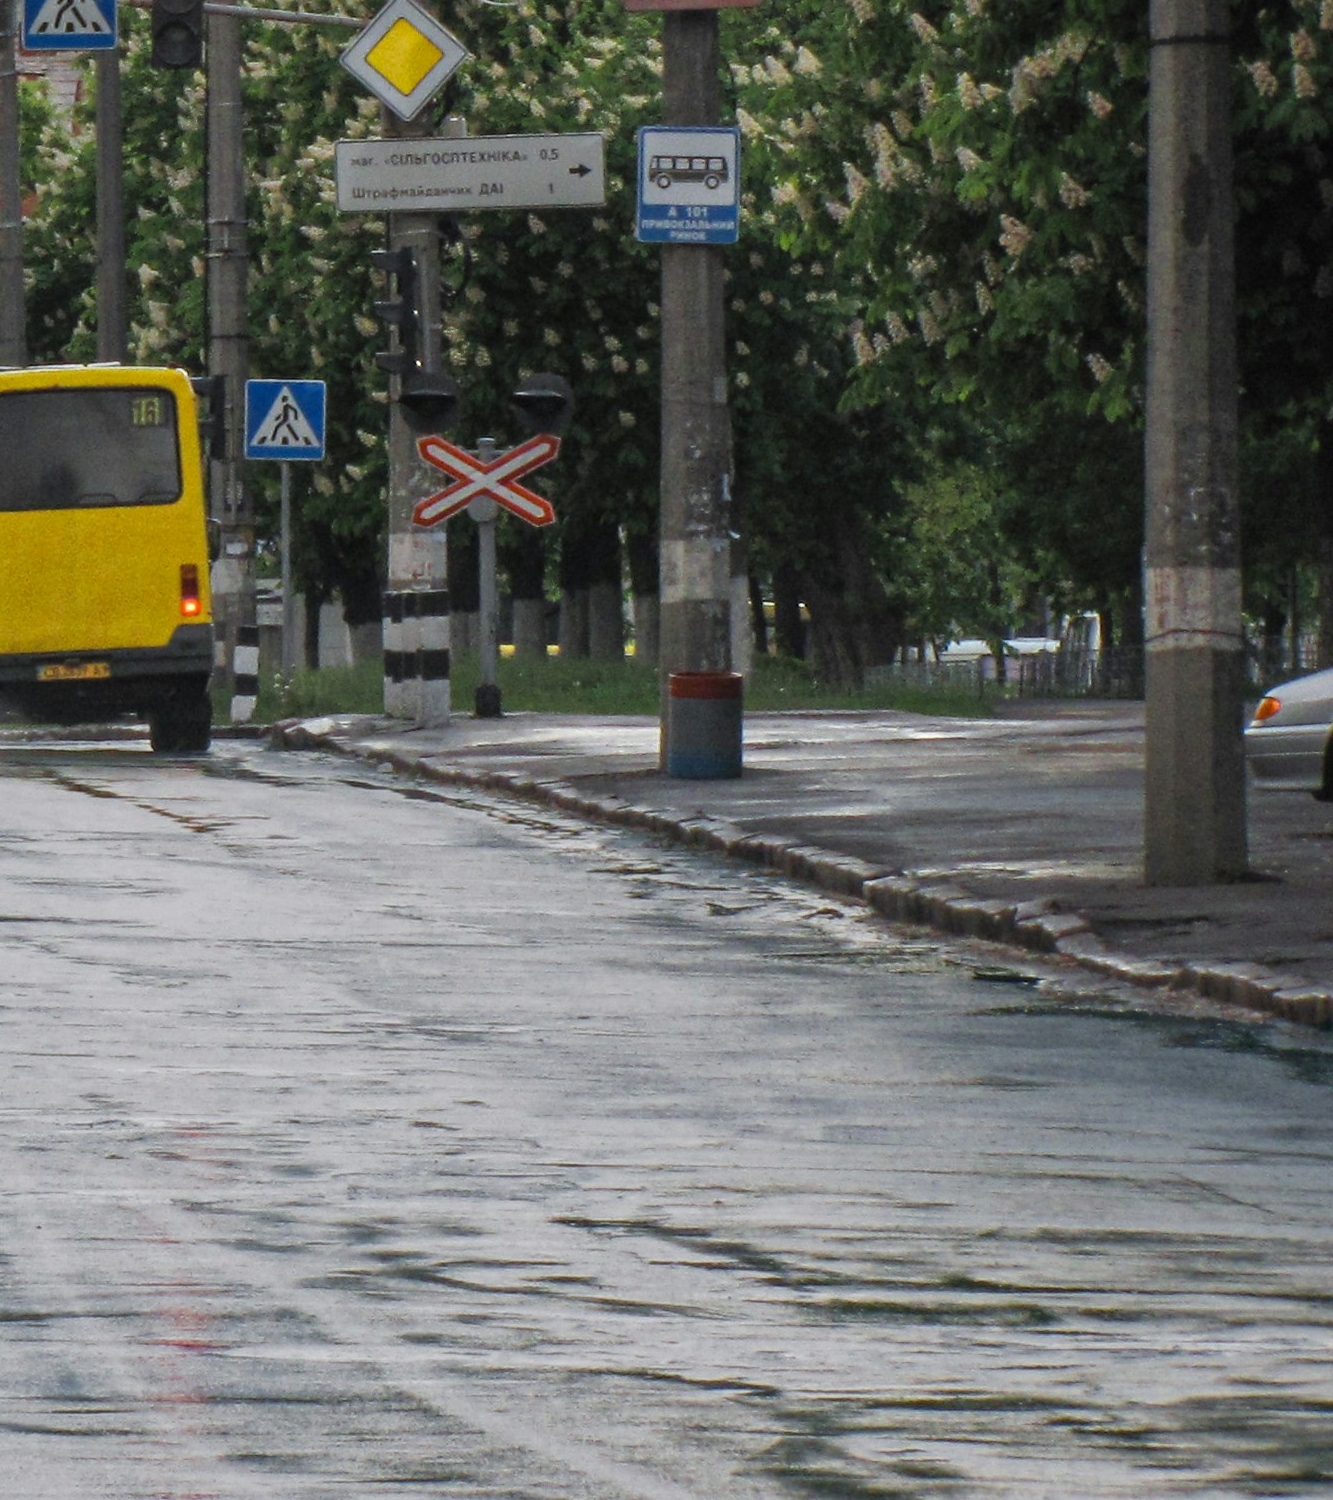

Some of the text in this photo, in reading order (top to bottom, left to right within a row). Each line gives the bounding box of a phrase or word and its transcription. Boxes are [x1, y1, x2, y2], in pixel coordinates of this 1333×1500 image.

[478, 183, 504, 197] ДАІ
[547, 183, 554, 195] 1
[686, 206, 708, 217] 101
